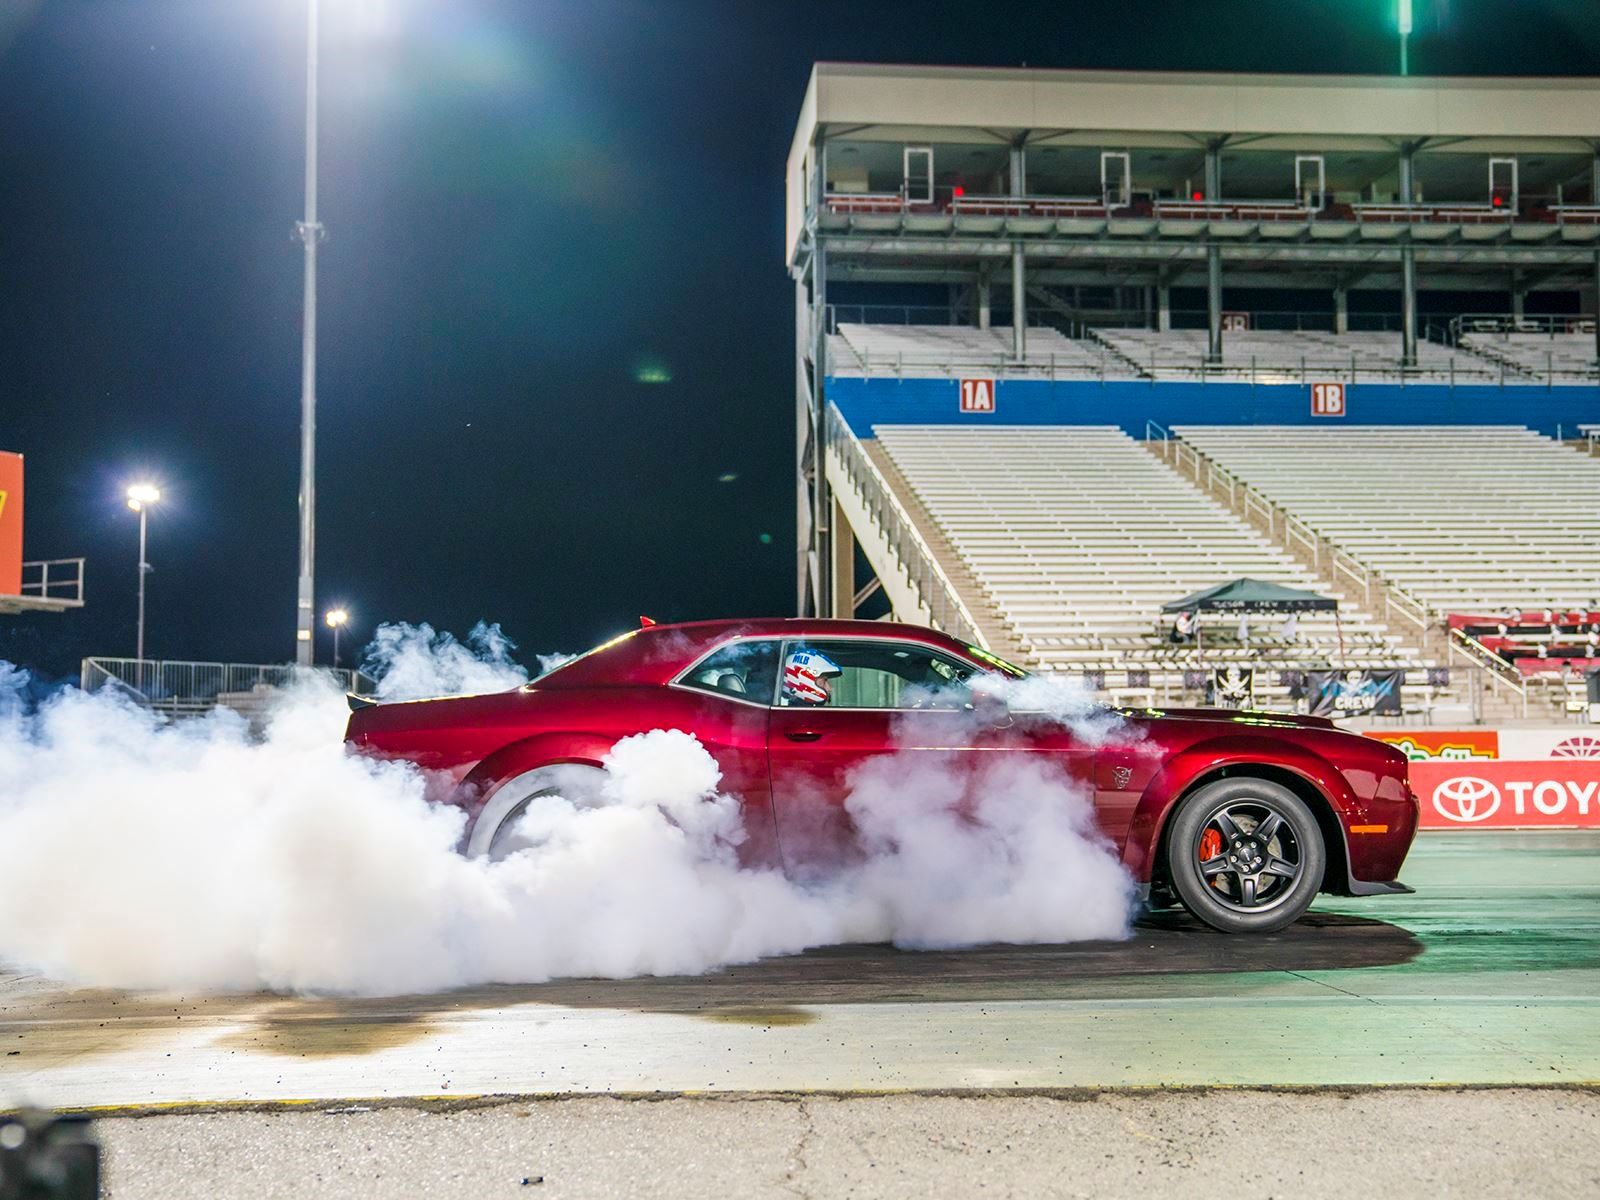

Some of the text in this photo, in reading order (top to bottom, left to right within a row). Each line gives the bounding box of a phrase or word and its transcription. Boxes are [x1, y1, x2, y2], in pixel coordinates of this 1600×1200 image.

[963, 381, 991, 409] 1A
[1315, 385, 1341, 413] 1B
[1334, 694, 1376, 710] CREW
[1504, 780, 1600, 815] TOY
